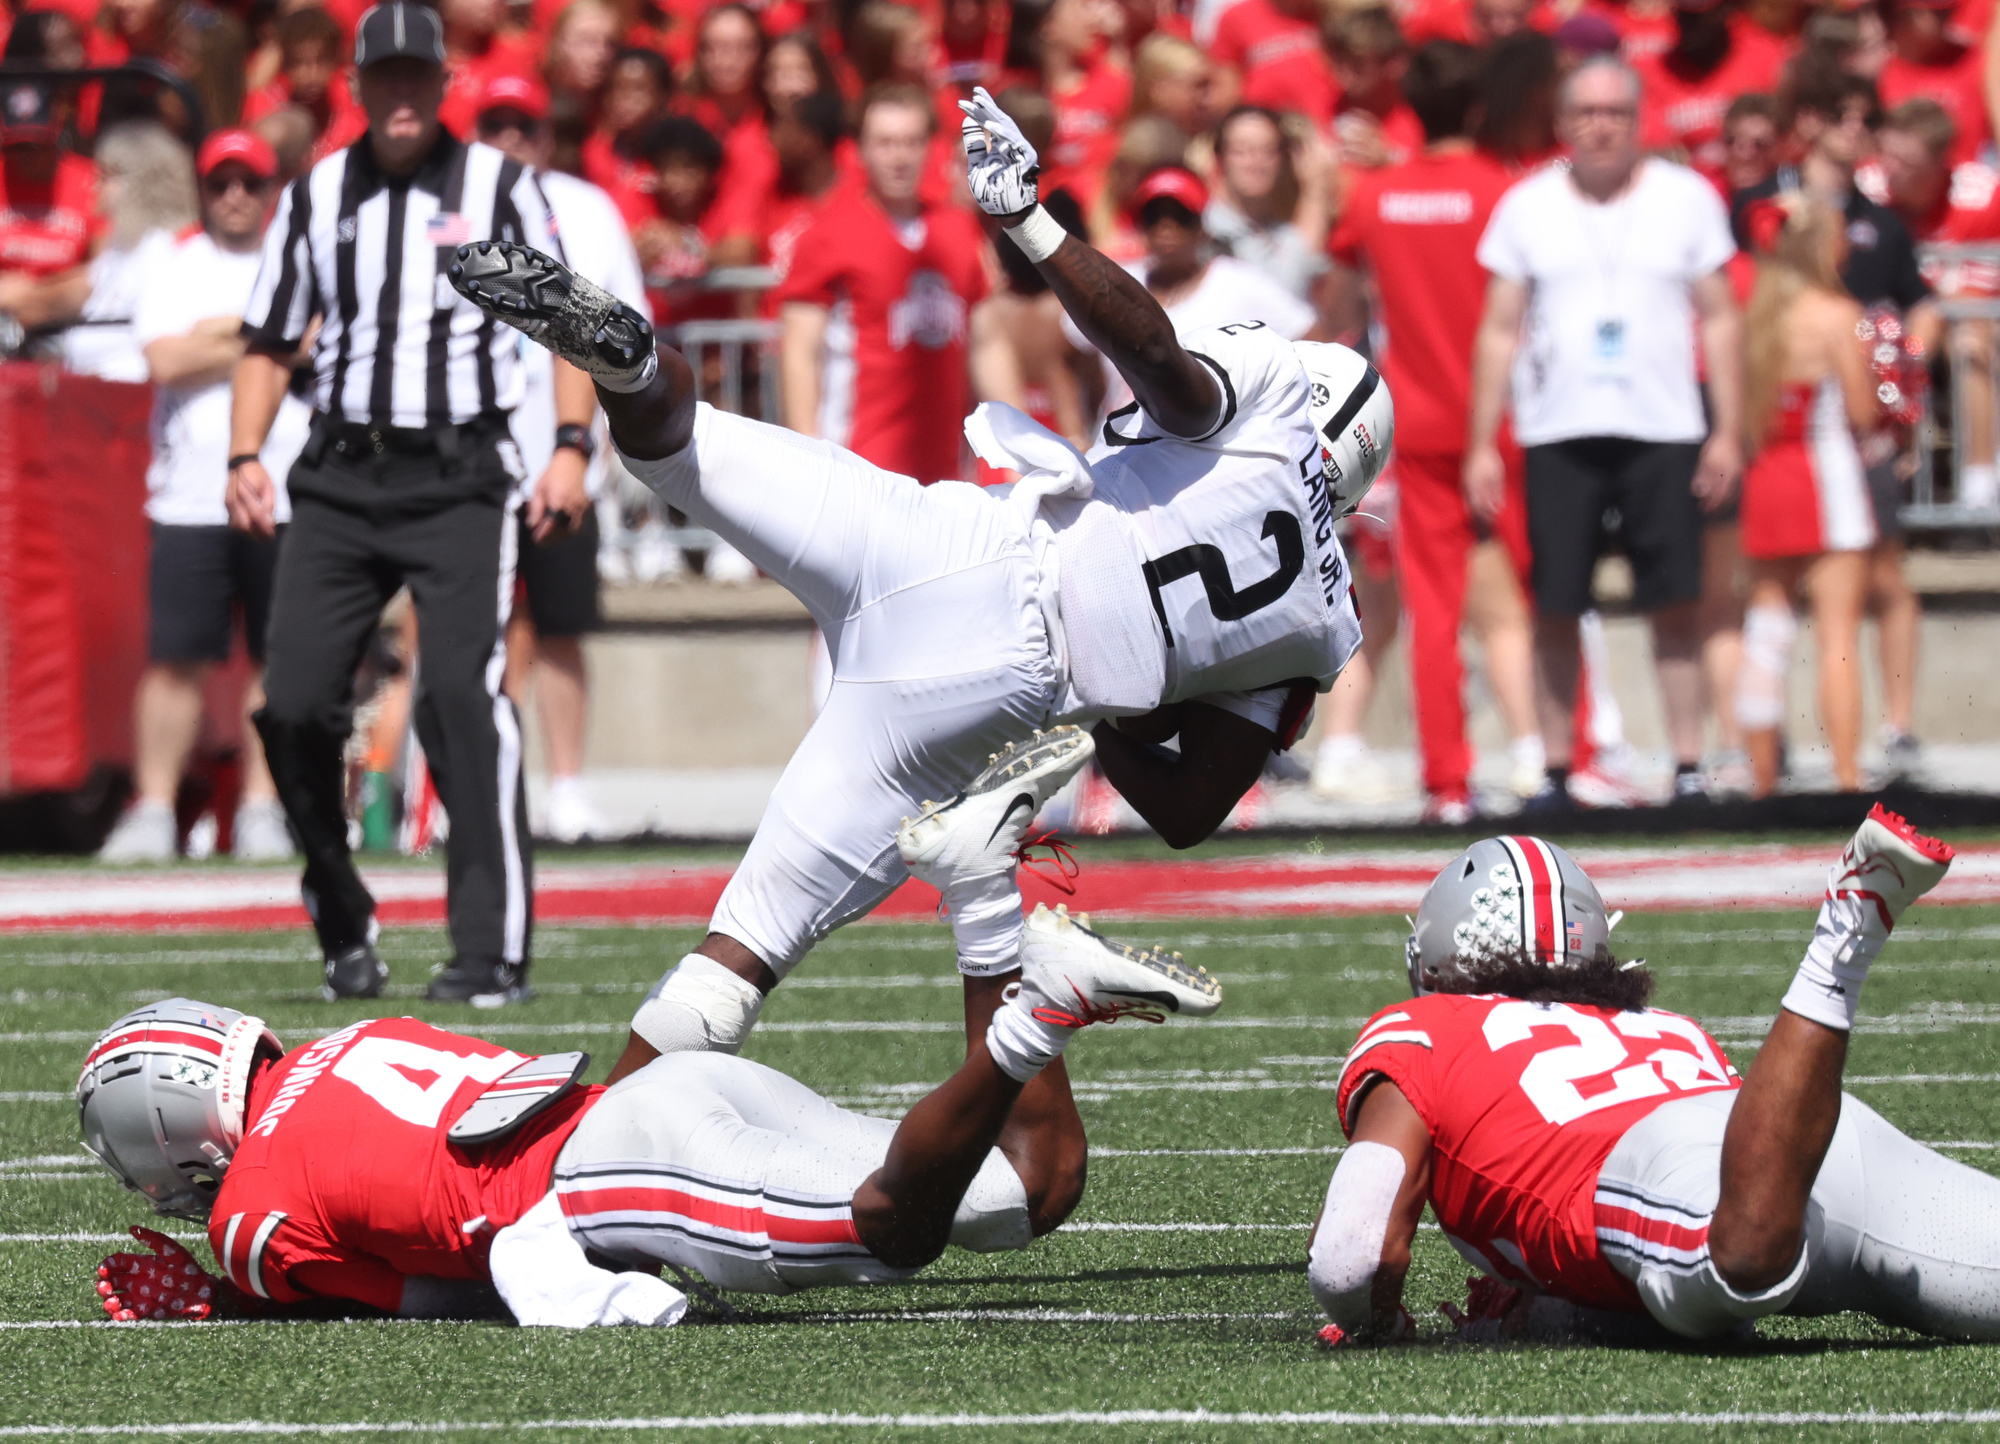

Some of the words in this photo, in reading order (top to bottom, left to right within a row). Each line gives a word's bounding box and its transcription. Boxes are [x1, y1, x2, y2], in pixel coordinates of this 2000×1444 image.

[1217, 319, 1267, 337] 2
[1298, 440, 1334, 550] LANG
[1319, 552, 1343, 607] JR.
[1141, 510, 1305, 649] 2
[1570, 938, 1582, 951] 22
[216, 1020, 228, 1029] 4
[222, 1019, 249, 1104] BUCKEYES
[1482, 1001, 1732, 1126] 22
[331, 1036, 533, 1129] 4
